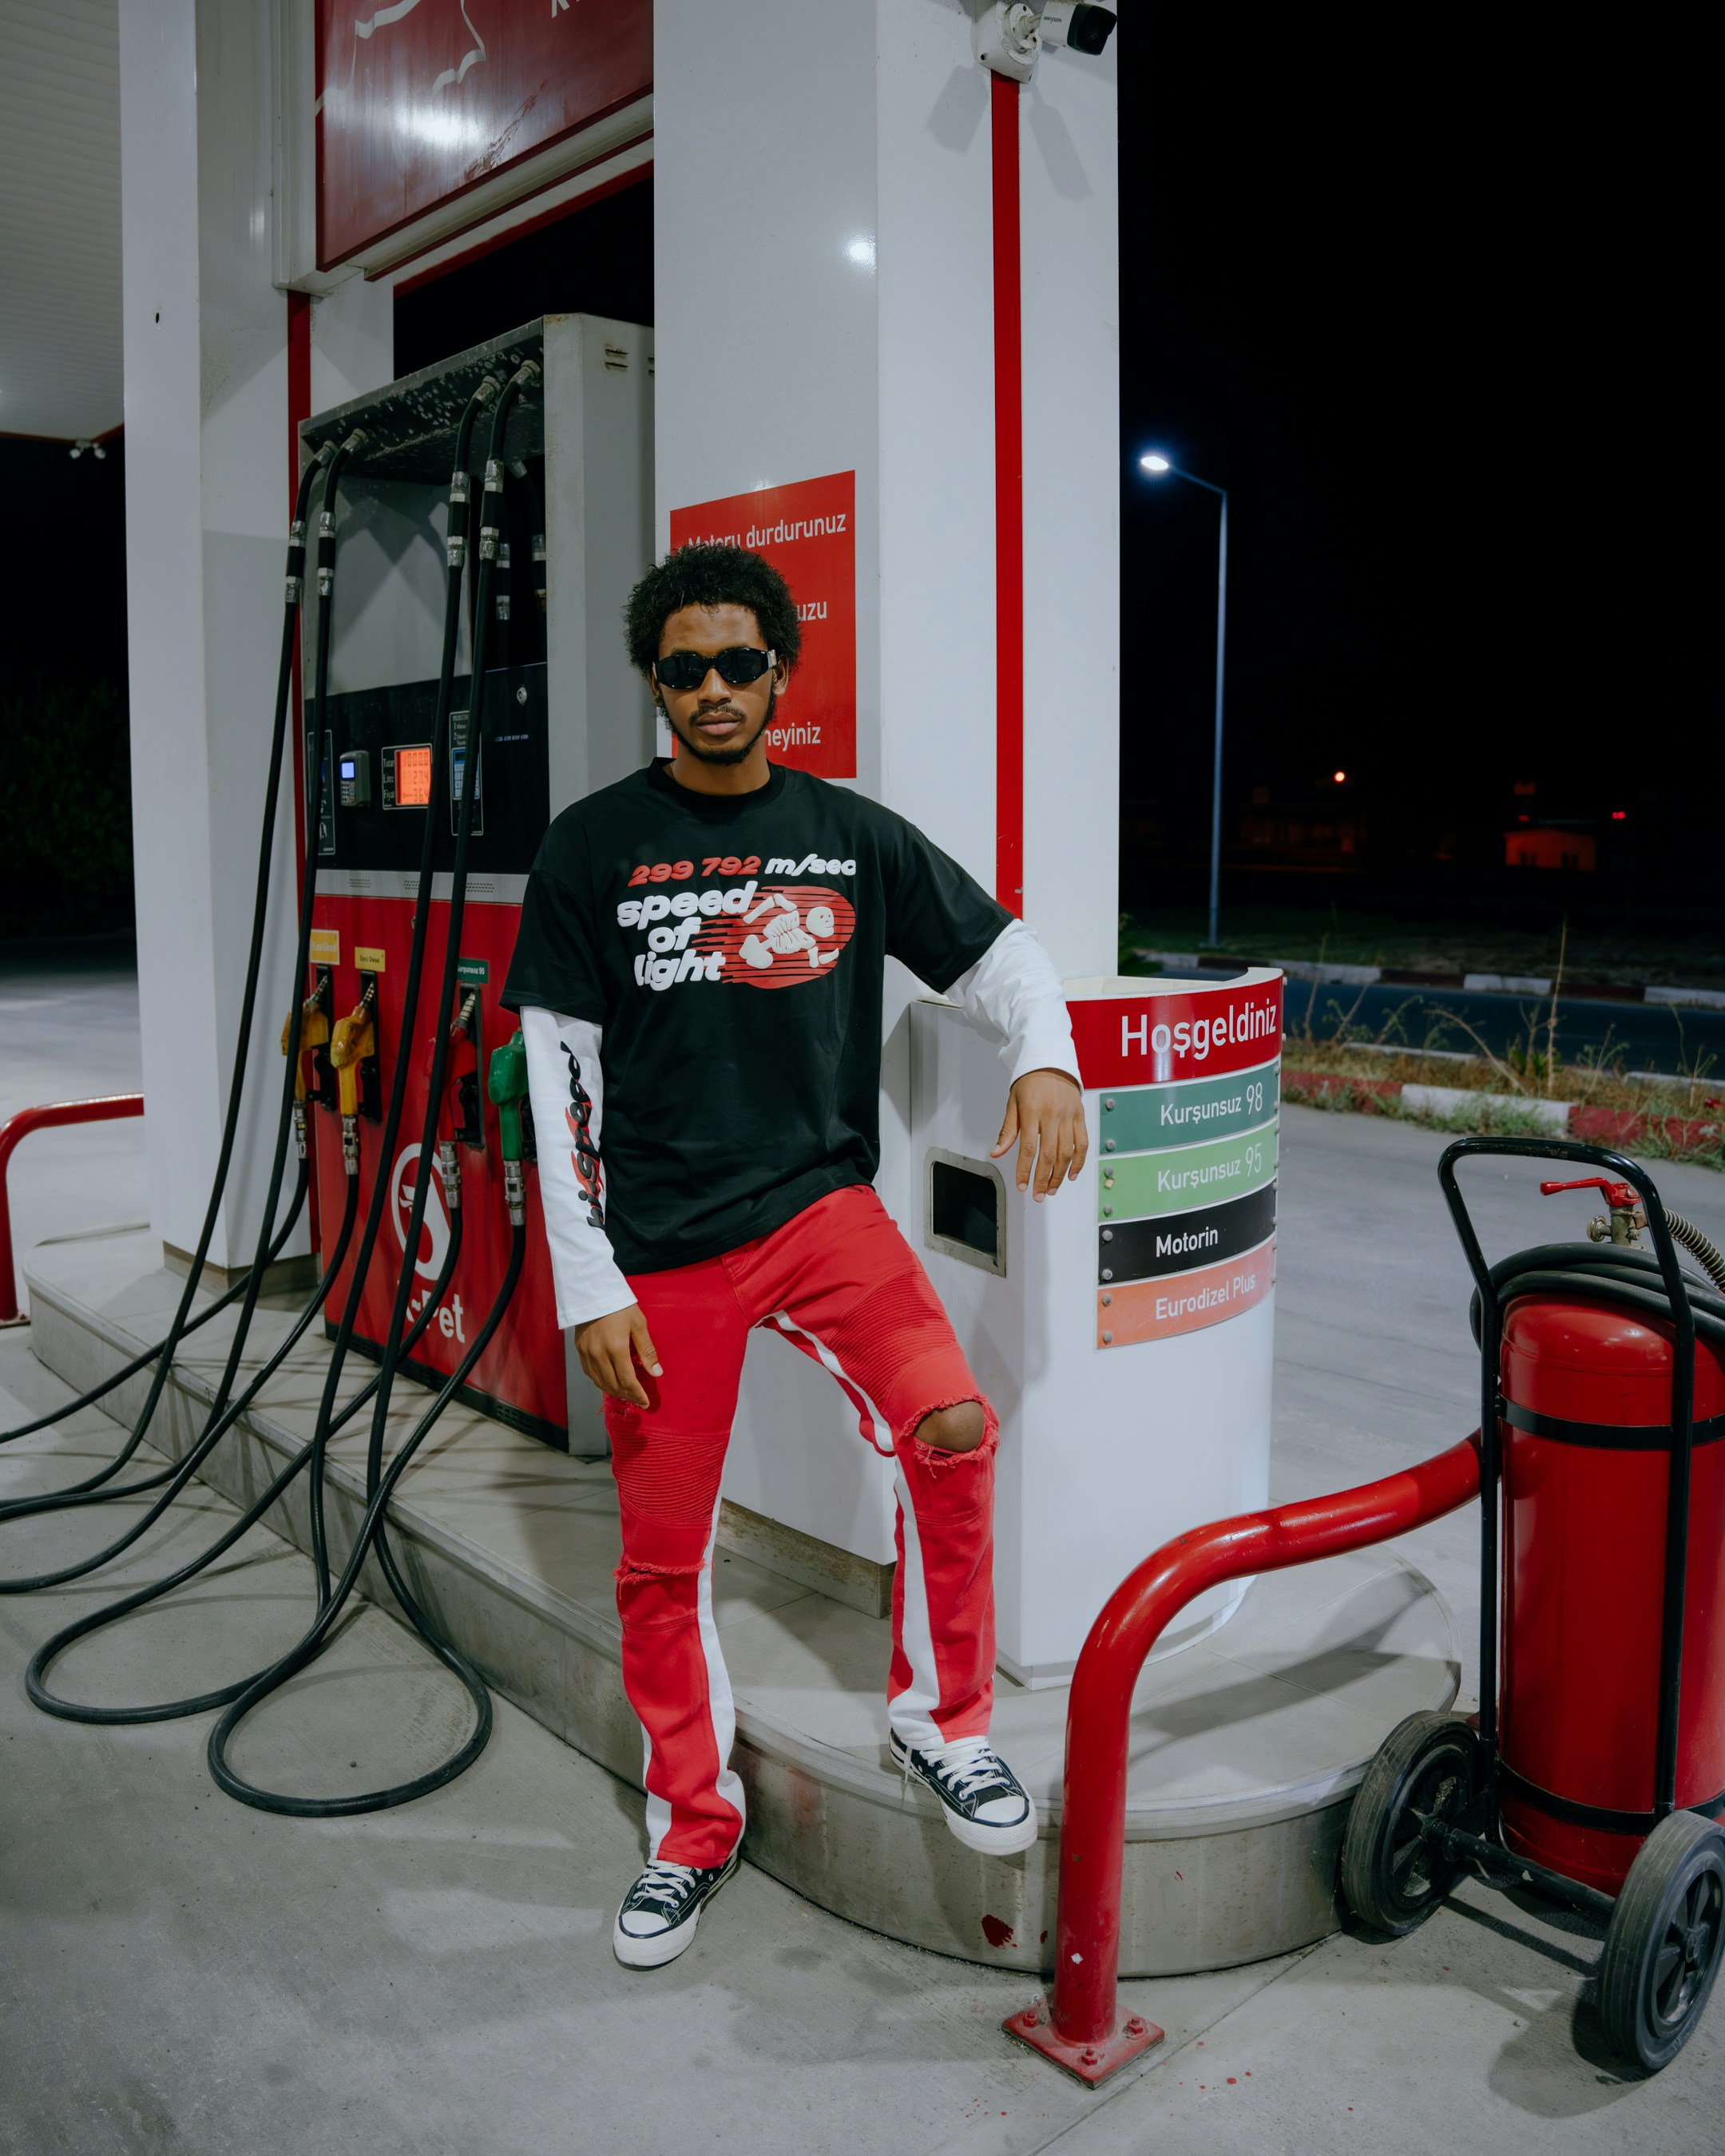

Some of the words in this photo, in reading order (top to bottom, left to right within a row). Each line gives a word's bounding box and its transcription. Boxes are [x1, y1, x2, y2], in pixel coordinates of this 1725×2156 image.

[746, 513, 847, 549] durdurunuz
[628, 860, 695, 887] 299
[701, 855, 762, 877] 792
[764, 853, 857, 877] m/sec
[617, 880, 759, 930] speed
[647, 917, 702, 953] of
[633, 949, 726, 992] light
[1121, 998, 1277, 1060] Hoşgeldiniz
[1160, 1096, 1242, 1126] Kurşunsuz
[1246, 1081, 1263, 1116] 98
[1158, 1159, 1241, 1192] Kurşunsuz
[1245, 1142, 1262, 1177] 95
[1156, 1226, 1219, 1258] Motorin
[1156, 1285, 1230, 1320] Eurodizel
[1232, 1274, 1256, 1298] Plus
